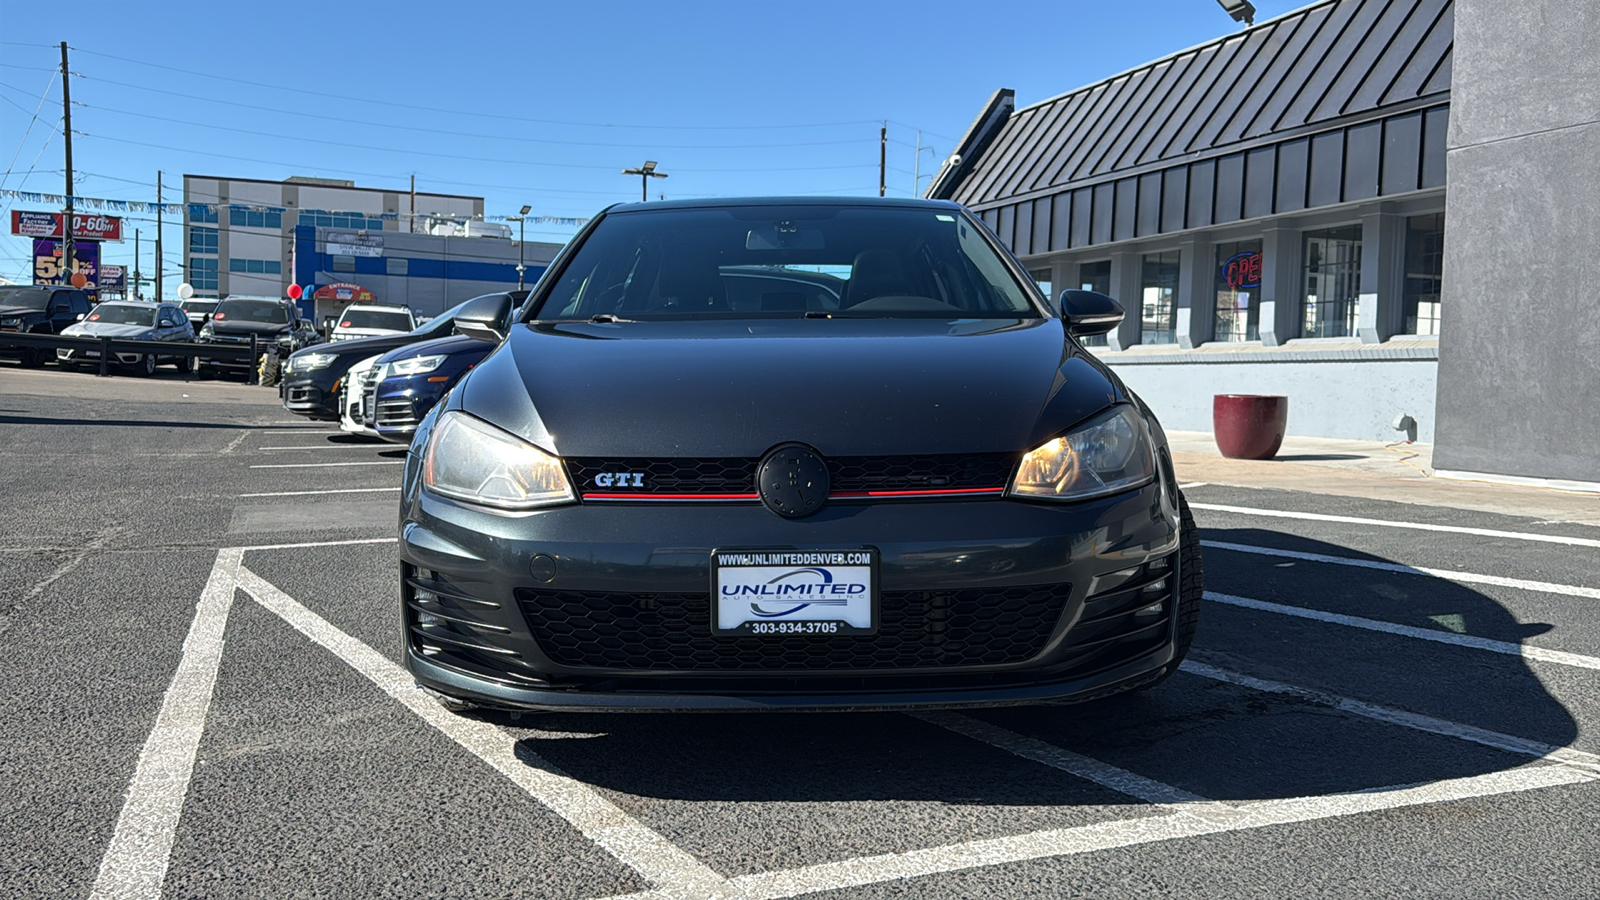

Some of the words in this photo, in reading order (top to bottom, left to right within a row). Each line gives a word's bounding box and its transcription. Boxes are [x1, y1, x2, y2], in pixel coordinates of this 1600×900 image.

[329, 283, 361, 291] ENTRANCE
[595, 472, 645, 487] GTI
[718, 553, 870, 565] WWWUNLIMITEDDENVER.COM
[722, 584, 866, 596] UNLIMITED
[752, 622, 837, 634] 303-934-3705
